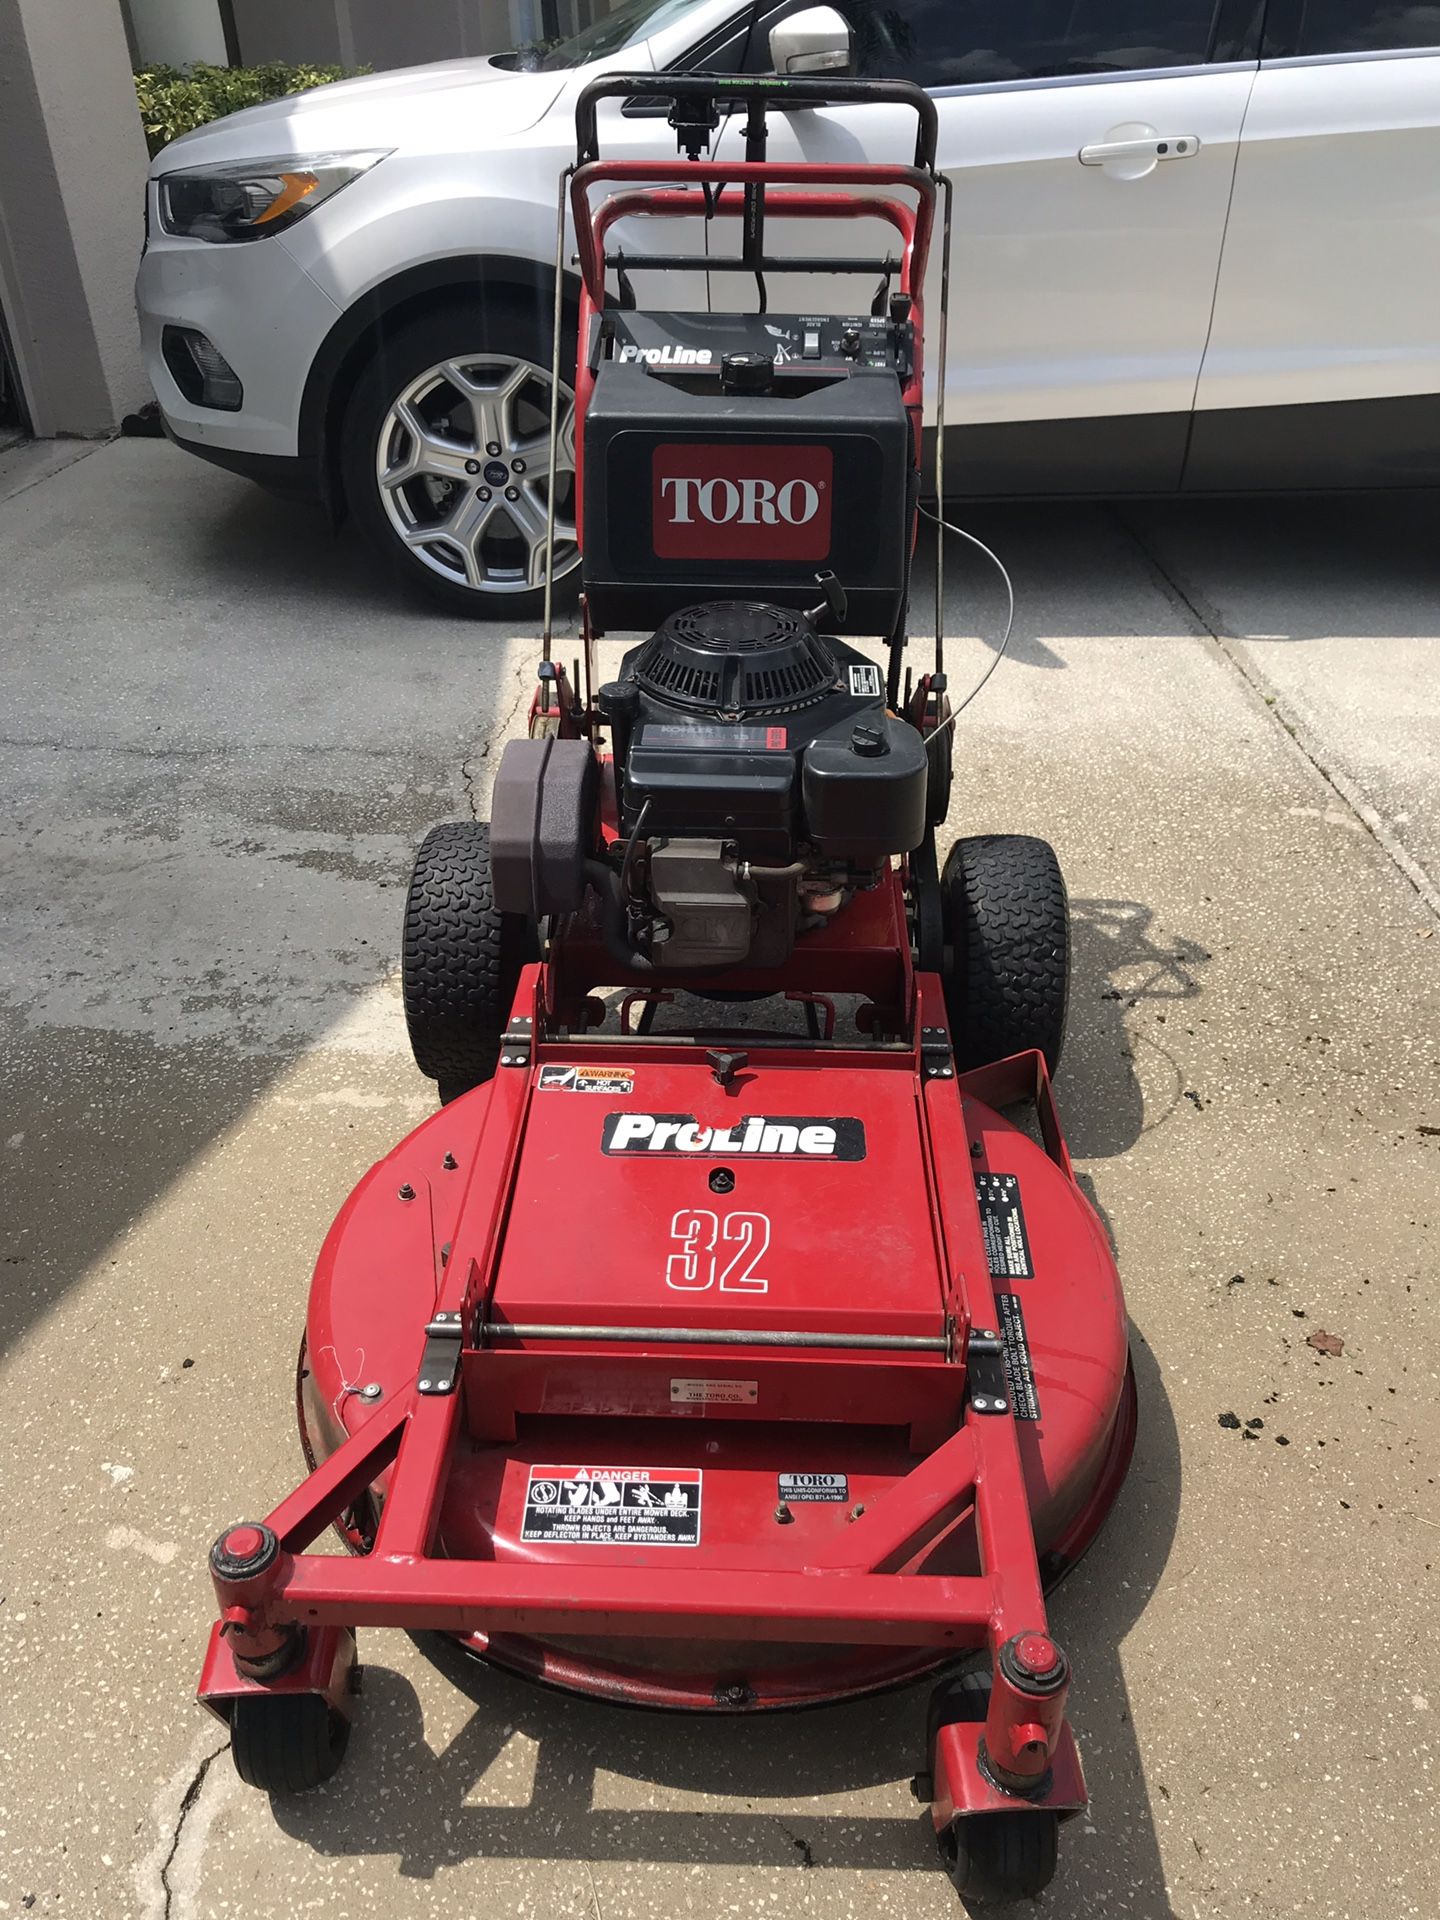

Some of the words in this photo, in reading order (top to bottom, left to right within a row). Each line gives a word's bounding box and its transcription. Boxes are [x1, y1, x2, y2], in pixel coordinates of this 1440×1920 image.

[619, 345, 712, 364] ProLine
[661, 478, 819, 524] TORO
[609, 1114, 836, 1154] ProLine
[987, 1215, 998, 1256] CORRESPONDING
[995, 1234, 1003, 1251] HEIGHT
[1008, 1223, 1018, 1251] POSITIONED
[666, 1209, 770, 1293] 32
[1005, 1246, 1013, 1259] SURE
[999, 1252, 1007, 1274] DESIRED
[1019, 1250, 1028, 1275] IDENTICAL
[1001, 1295, 1010, 1315] AFTER
[1004, 1317, 1015, 1345] TORQUE
[1013, 1314, 1023, 1341] OBJECT.
[1009, 1347, 1019, 1365] BOLT
[1017, 1343, 1027, 1364] SOLID
[1013, 1366, 1023, 1390] BLADE
[1021, 1366, 1030, 1382] ANY
[1017, 1392, 1028, 1417] CHECK
[1024, 1383, 1037, 1419] STRIKING
[592, 1470, 650, 1481] DANGER
[790, 1475, 835, 1486] TORO
[595, 1508, 617, 1516] UNDER
[620, 1516, 635, 1524] FEET
[637, 1516, 656, 1524] AWAY.
[524, 1530, 542, 1538] KEEP
[544, 1531, 580, 1539] DEFLECTOR
[591, 1532, 614, 1540] PLACE.
[634, 1534, 676, 1542] BYSTANDERS
[677, 1534, 696, 1542] AWAY.
[582, 1524, 611, 1532] OBJECTS
[628, 1526, 668, 1534] DANGEROUS.
